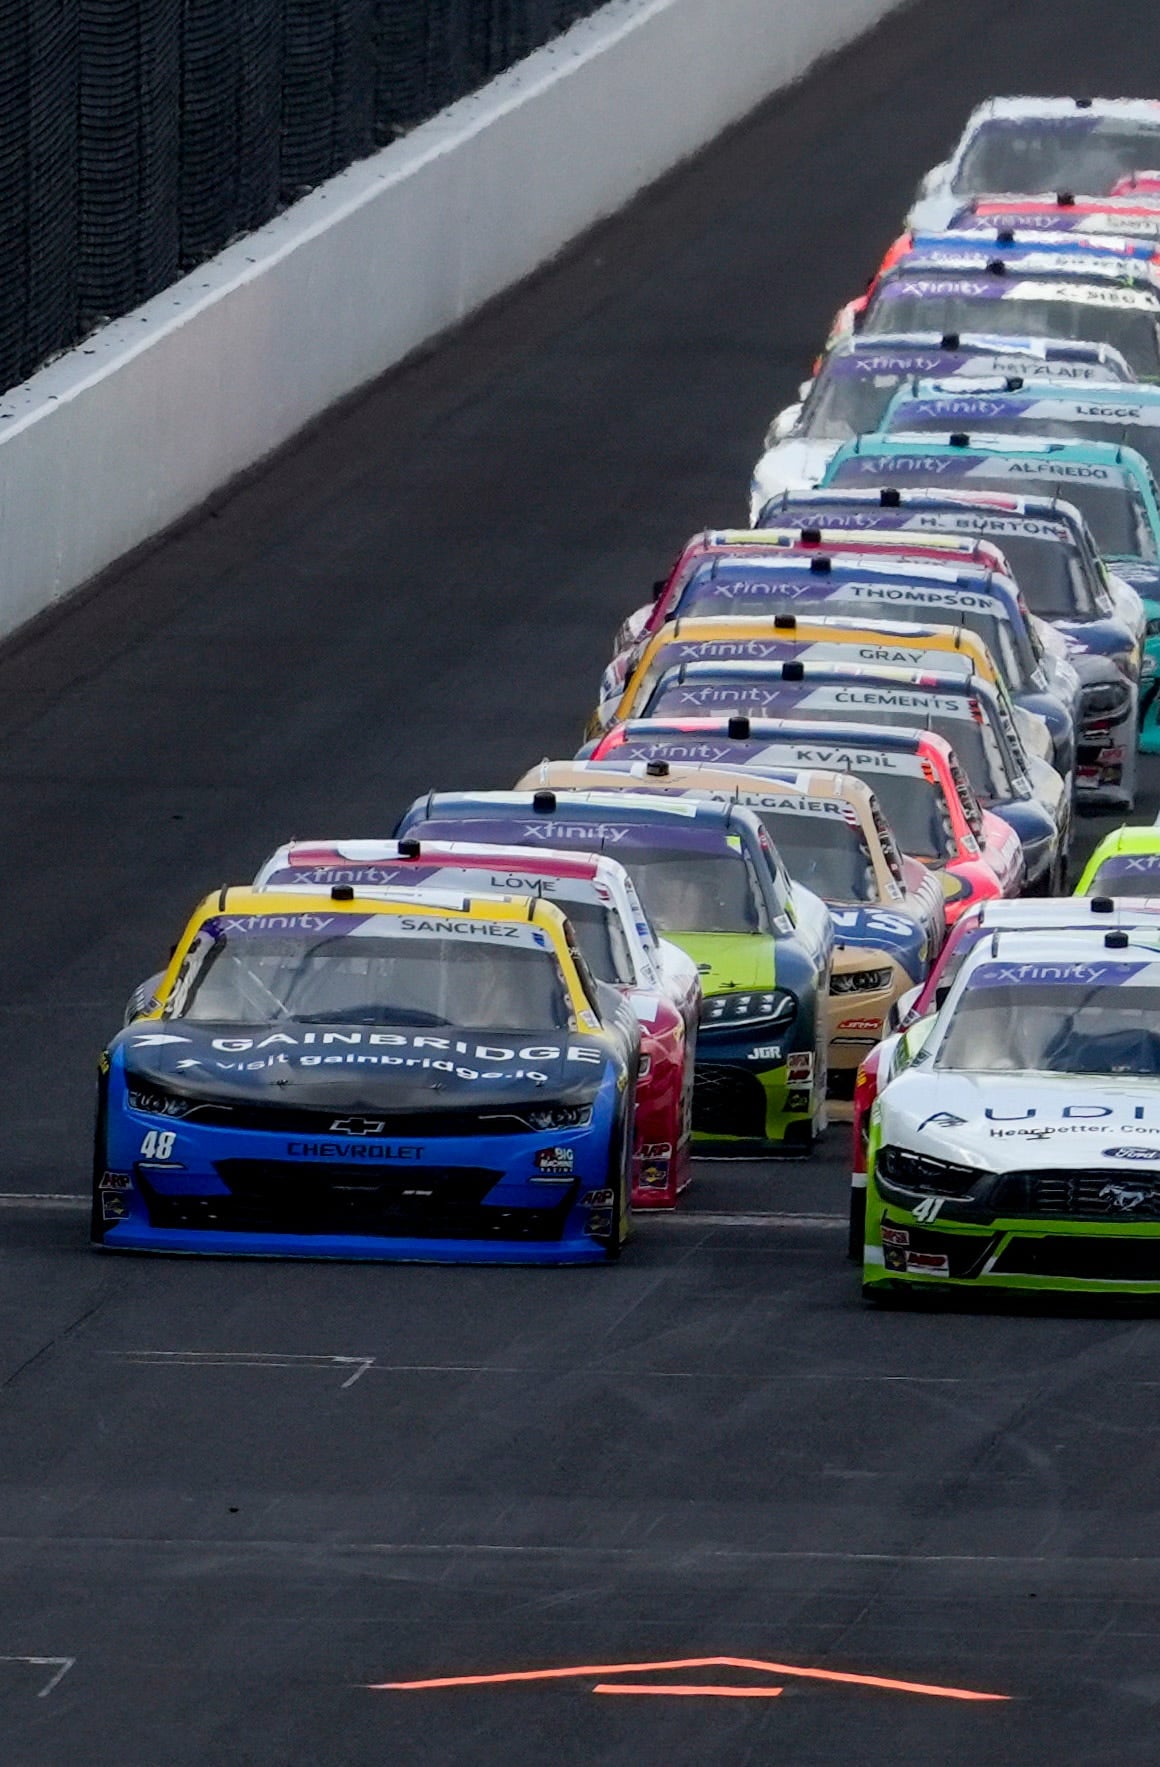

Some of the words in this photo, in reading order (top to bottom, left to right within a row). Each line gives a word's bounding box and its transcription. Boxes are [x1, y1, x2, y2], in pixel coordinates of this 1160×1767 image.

[976, 214, 1061, 228] xfinity
[902, 281, 990, 297] xfinity
[855, 355, 941, 371] xfinity
[916, 400, 1006, 417] xfinity
[860, 456, 952, 473] xfinity
[1007, 462, 1109, 480] ALFREDO
[790, 513, 881, 530] xfinity
[919, 516, 948, 529] H.
[956, 518, 1056, 535] BURTON
[712, 580, 811, 598] xfinity
[851, 586, 994, 609] THOMPSON
[679, 641, 777, 658] xfinity
[858, 648, 924, 665] GRAY
[680, 686, 781, 705] xfinity
[834, 692, 960, 711] CLEMENTS
[629, 743, 732, 762] xfinity
[797, 750, 898, 769] KVAPIL
[709, 795, 844, 816] ALLGAIER
[522, 823, 630, 843] xfinity
[294, 868, 400, 886] xfinity
[490, 876, 558, 892] LOVE
[225, 914, 335, 933] xfinity
[400, 919, 521, 939] SANCHEZ
[996, 964, 1108, 983] xfinity
[211, 1032, 602, 1064] GAINBRIDGE
[746, 1045, 782, 1060] JGR
[216, 1053, 289, 1071] visit
[300, 1054, 549, 1082] gainbridge.io
[989, 1127, 1044, 1139] Hear
[1044, 1124, 1114, 1135] better.
[140, 1130, 177, 1160] 48
[287, 1141, 424, 1160] CHEVROLET
[555, 1147, 574, 1161] BIG
[1113, 1146, 1157, 1160] Ford
[911, 1197, 946, 1223] 41
